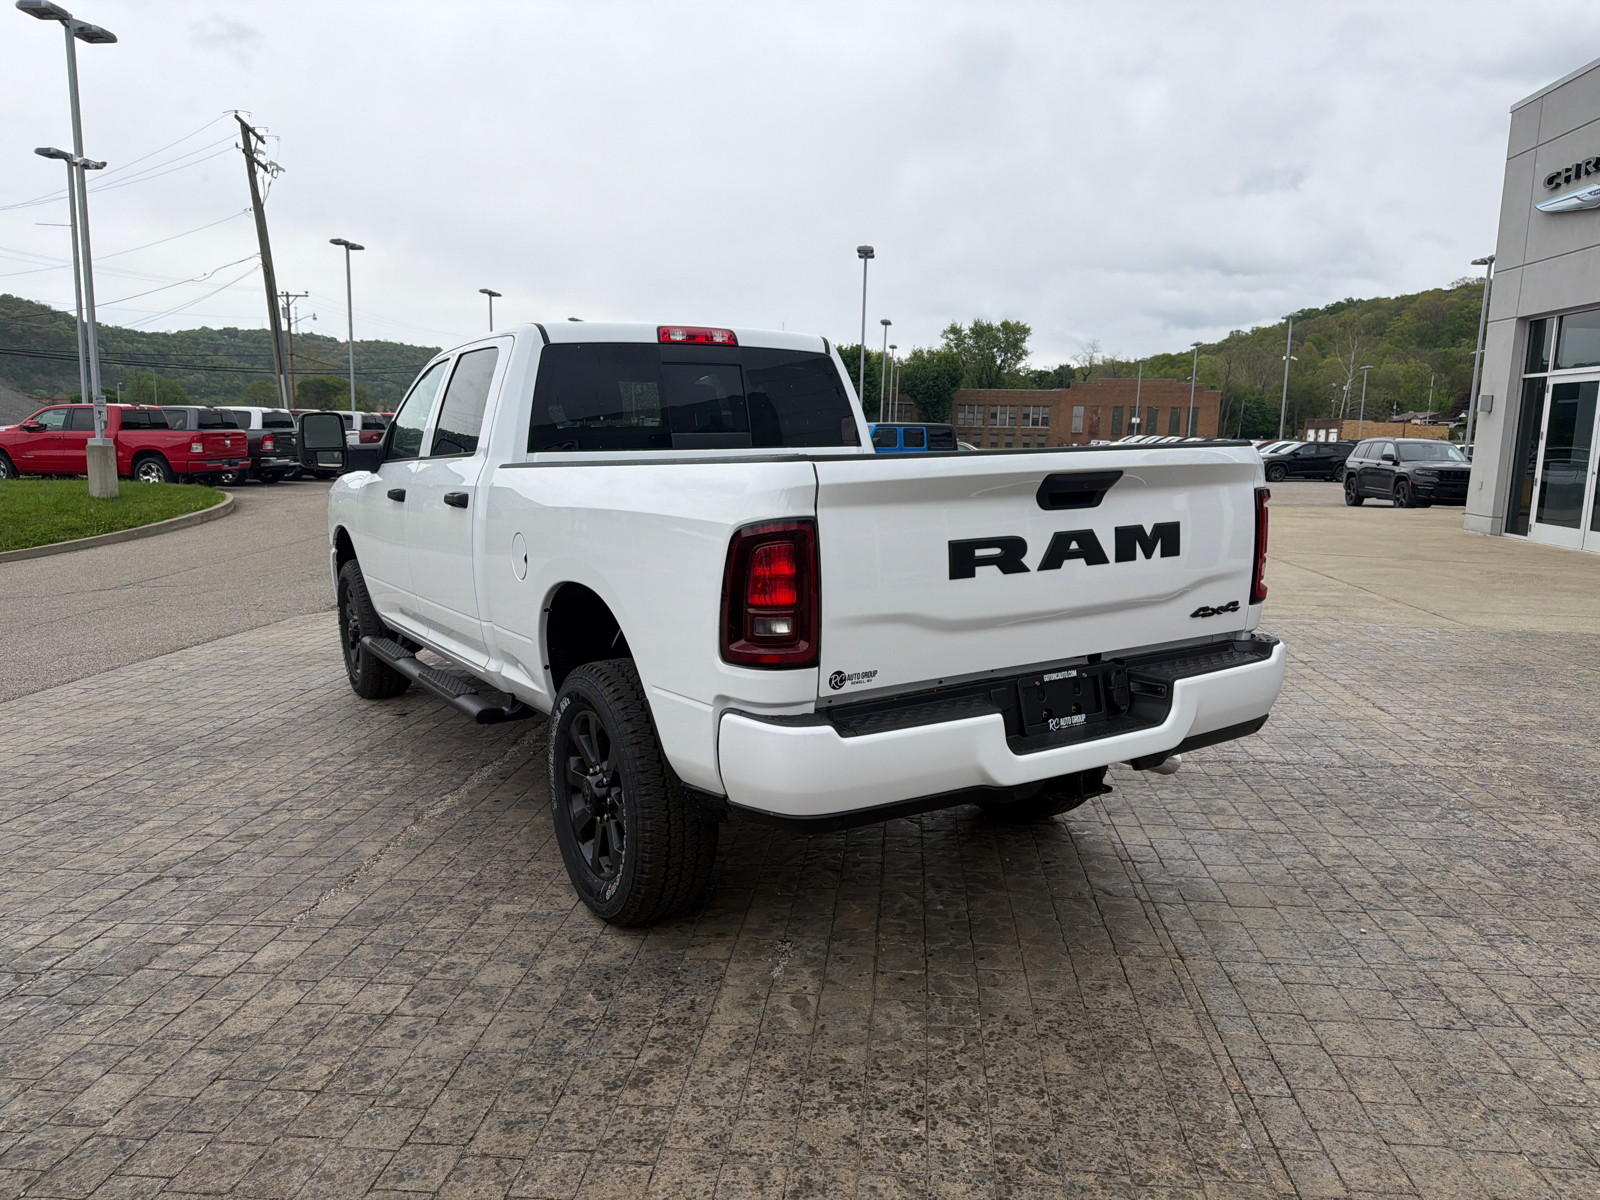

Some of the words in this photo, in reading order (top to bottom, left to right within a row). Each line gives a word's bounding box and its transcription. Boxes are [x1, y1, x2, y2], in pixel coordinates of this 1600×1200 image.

[948, 521, 1180, 580] RAM
[831, 673, 846, 689] RC
[847, 673, 861, 681] AUTO
[861, 670, 878, 679] GROUP
[1048, 718, 1060, 731] RC
[1060, 716, 1071, 726] AUTO
[1072, 713, 1086, 724] GROUP
